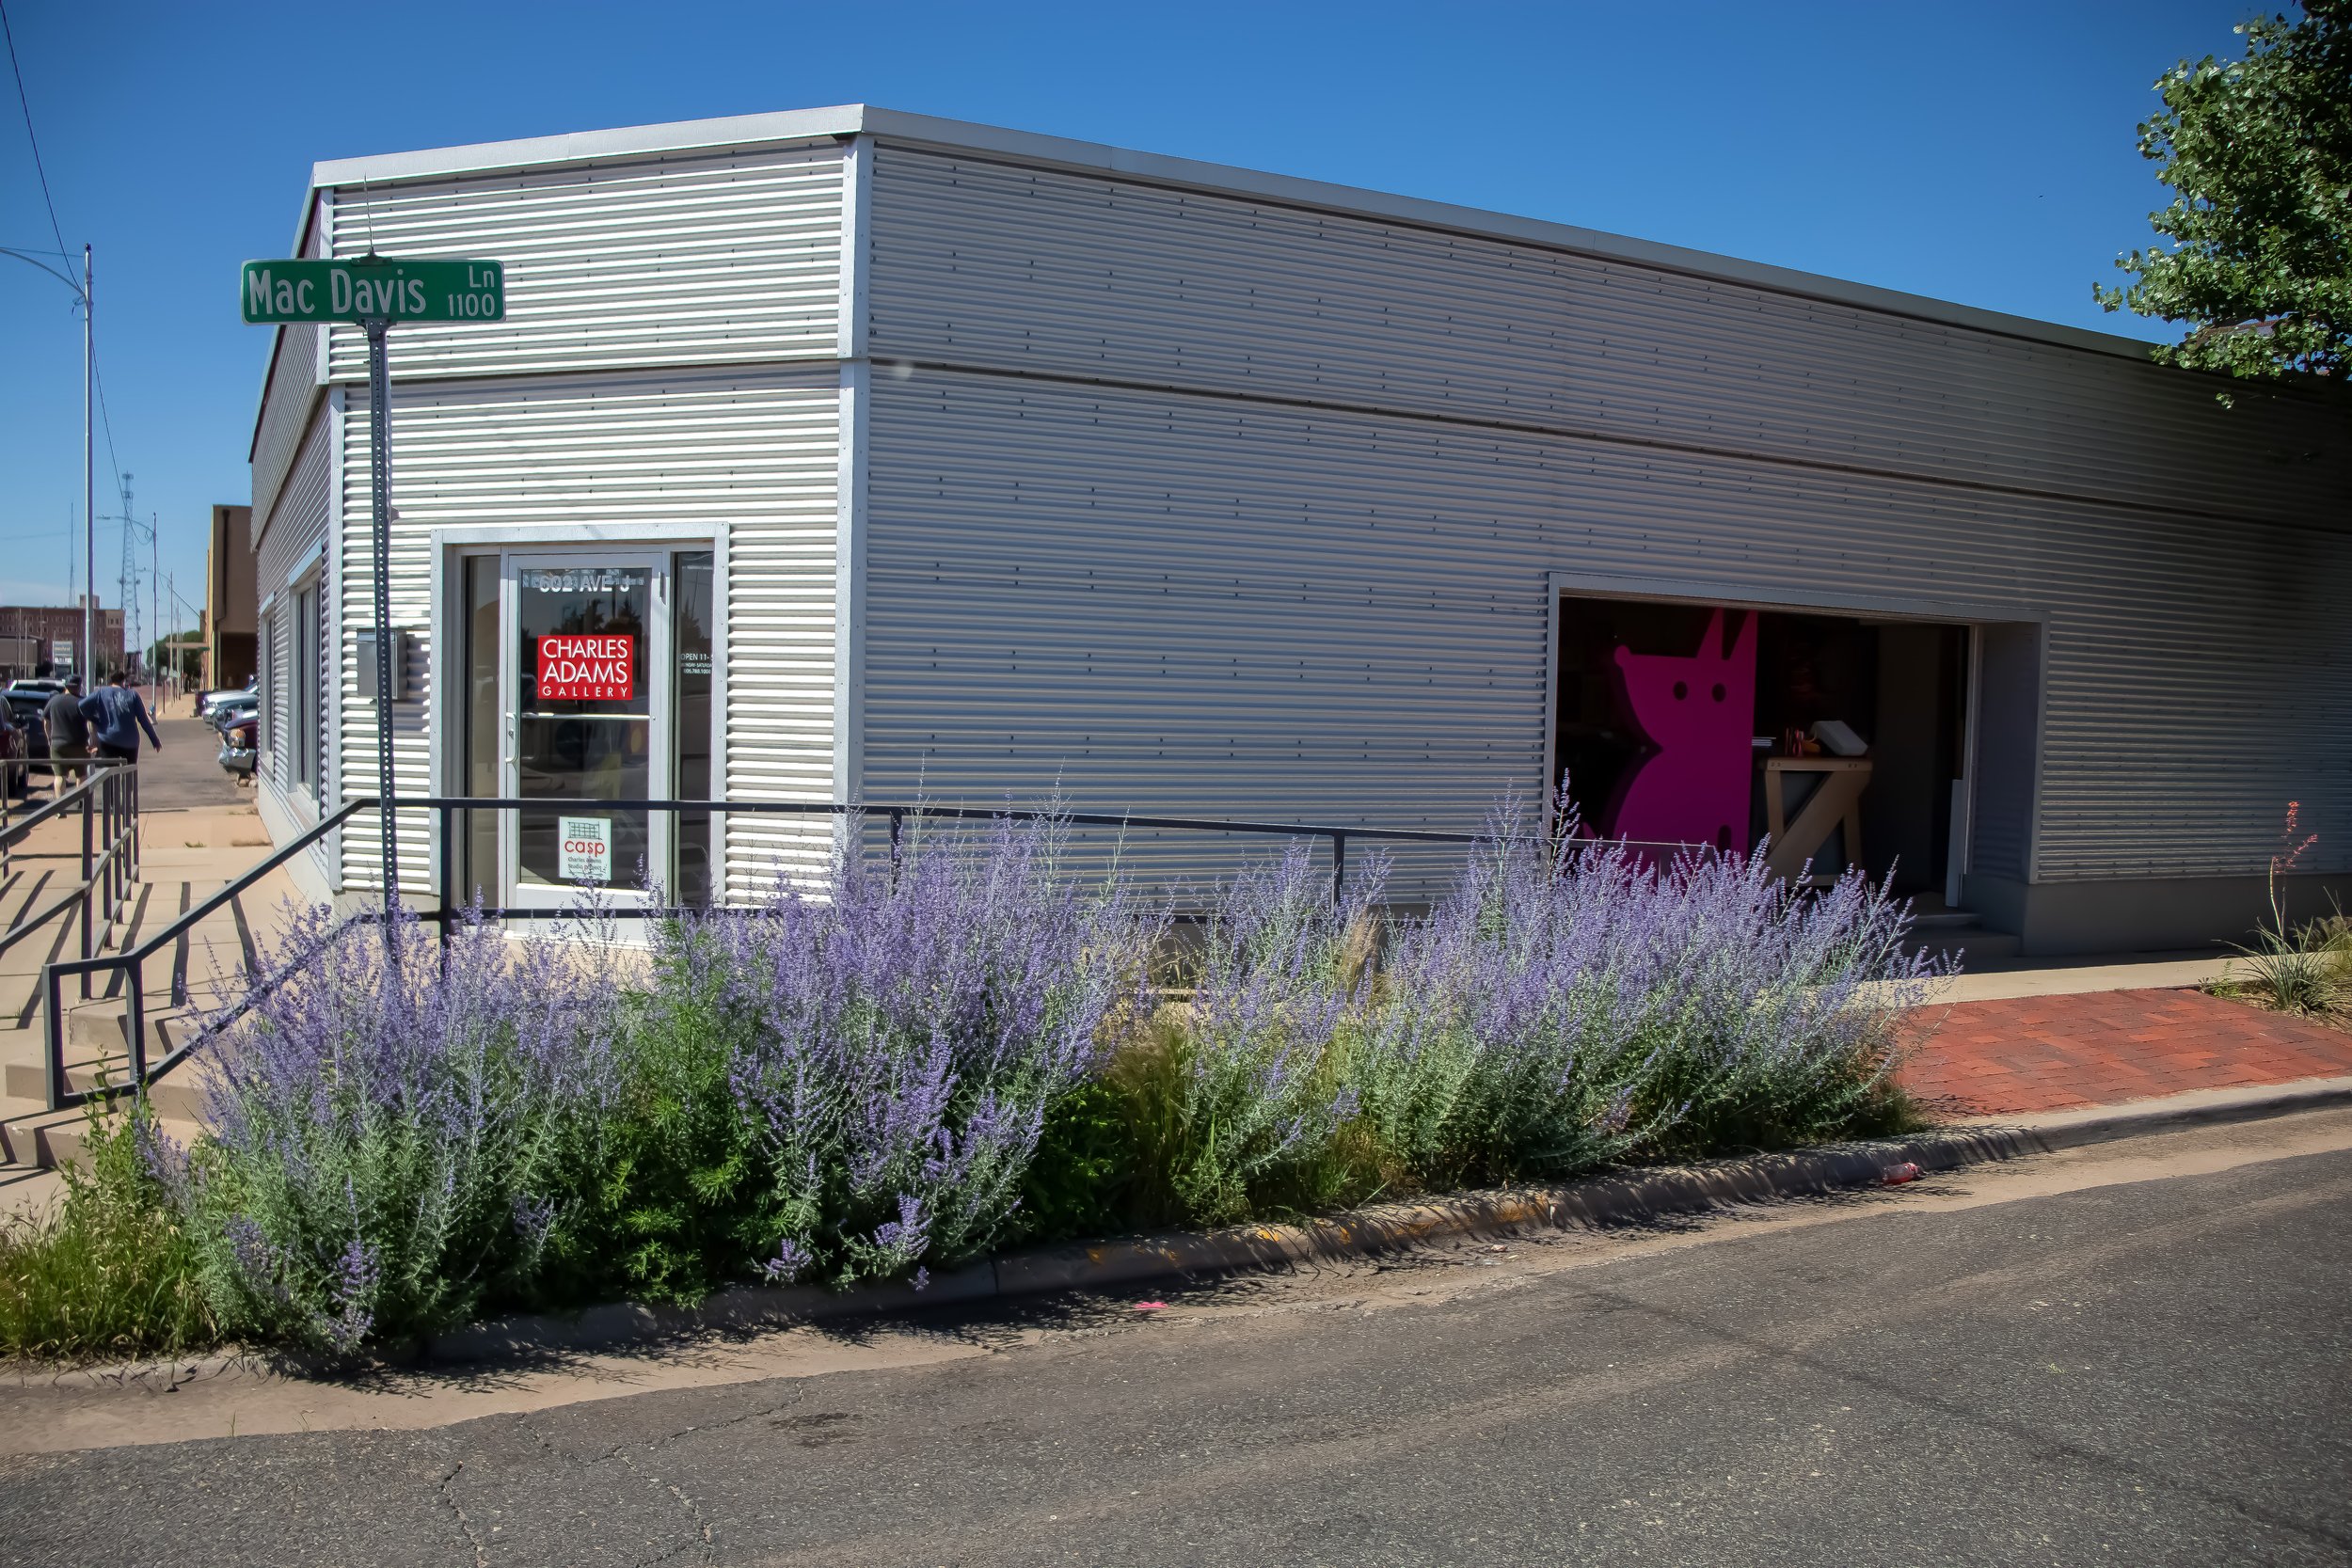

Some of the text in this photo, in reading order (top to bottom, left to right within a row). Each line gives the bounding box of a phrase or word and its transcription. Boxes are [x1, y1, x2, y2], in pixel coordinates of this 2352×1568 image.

[248, 265, 495, 315] Mac Davis Ln
[448, 293, 495, 317] 1100
[540, 575, 630, 593] 602 AVE J
[543, 639, 628, 658] CHARLES
[543, 660, 628, 684] ADAMS
[543, 686, 628, 697] GALLERY
[564, 840, 605, 857] casp
